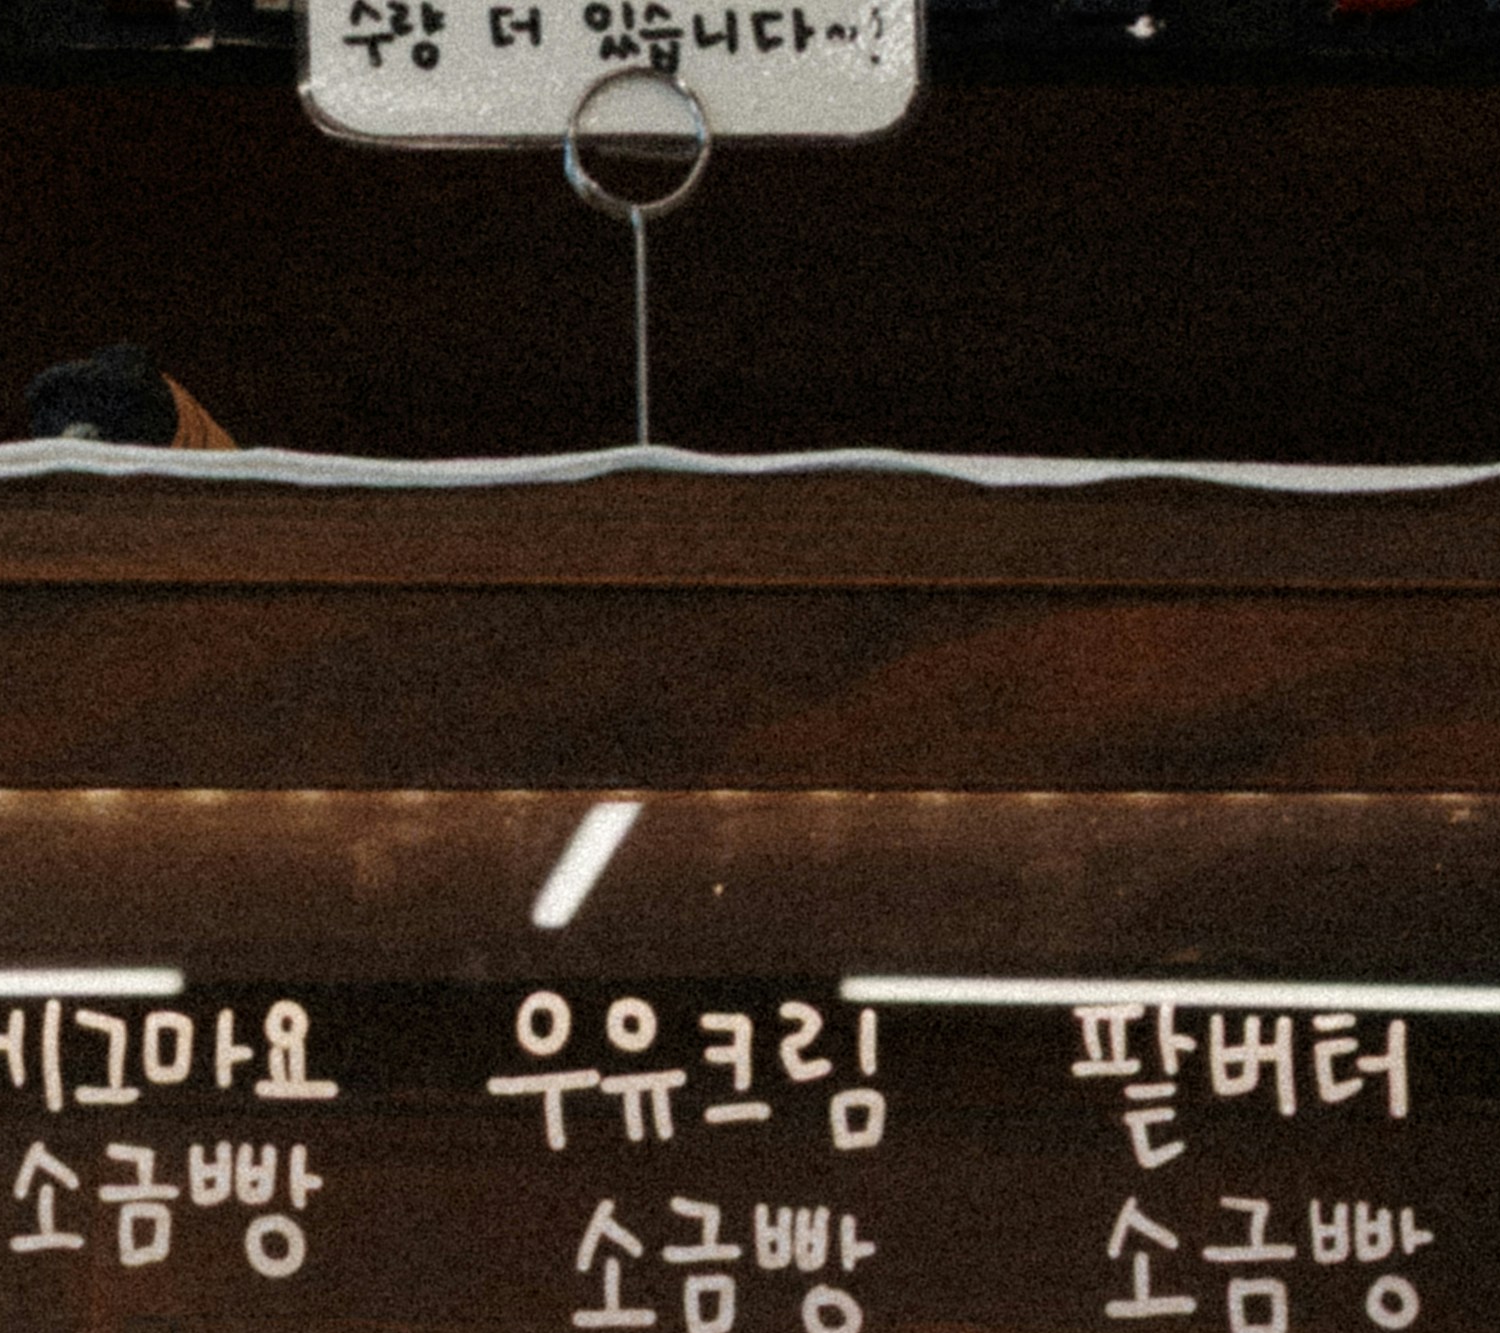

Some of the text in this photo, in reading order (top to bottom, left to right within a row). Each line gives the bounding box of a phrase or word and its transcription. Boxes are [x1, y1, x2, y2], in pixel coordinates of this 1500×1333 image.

[490, 5, 541, 47] 더
[486, 990, 887, 1151] 우유크림
[1071, 1001, 1410, 1170] 팥버터
[9, 1140, 325, 1278] 소금빵
